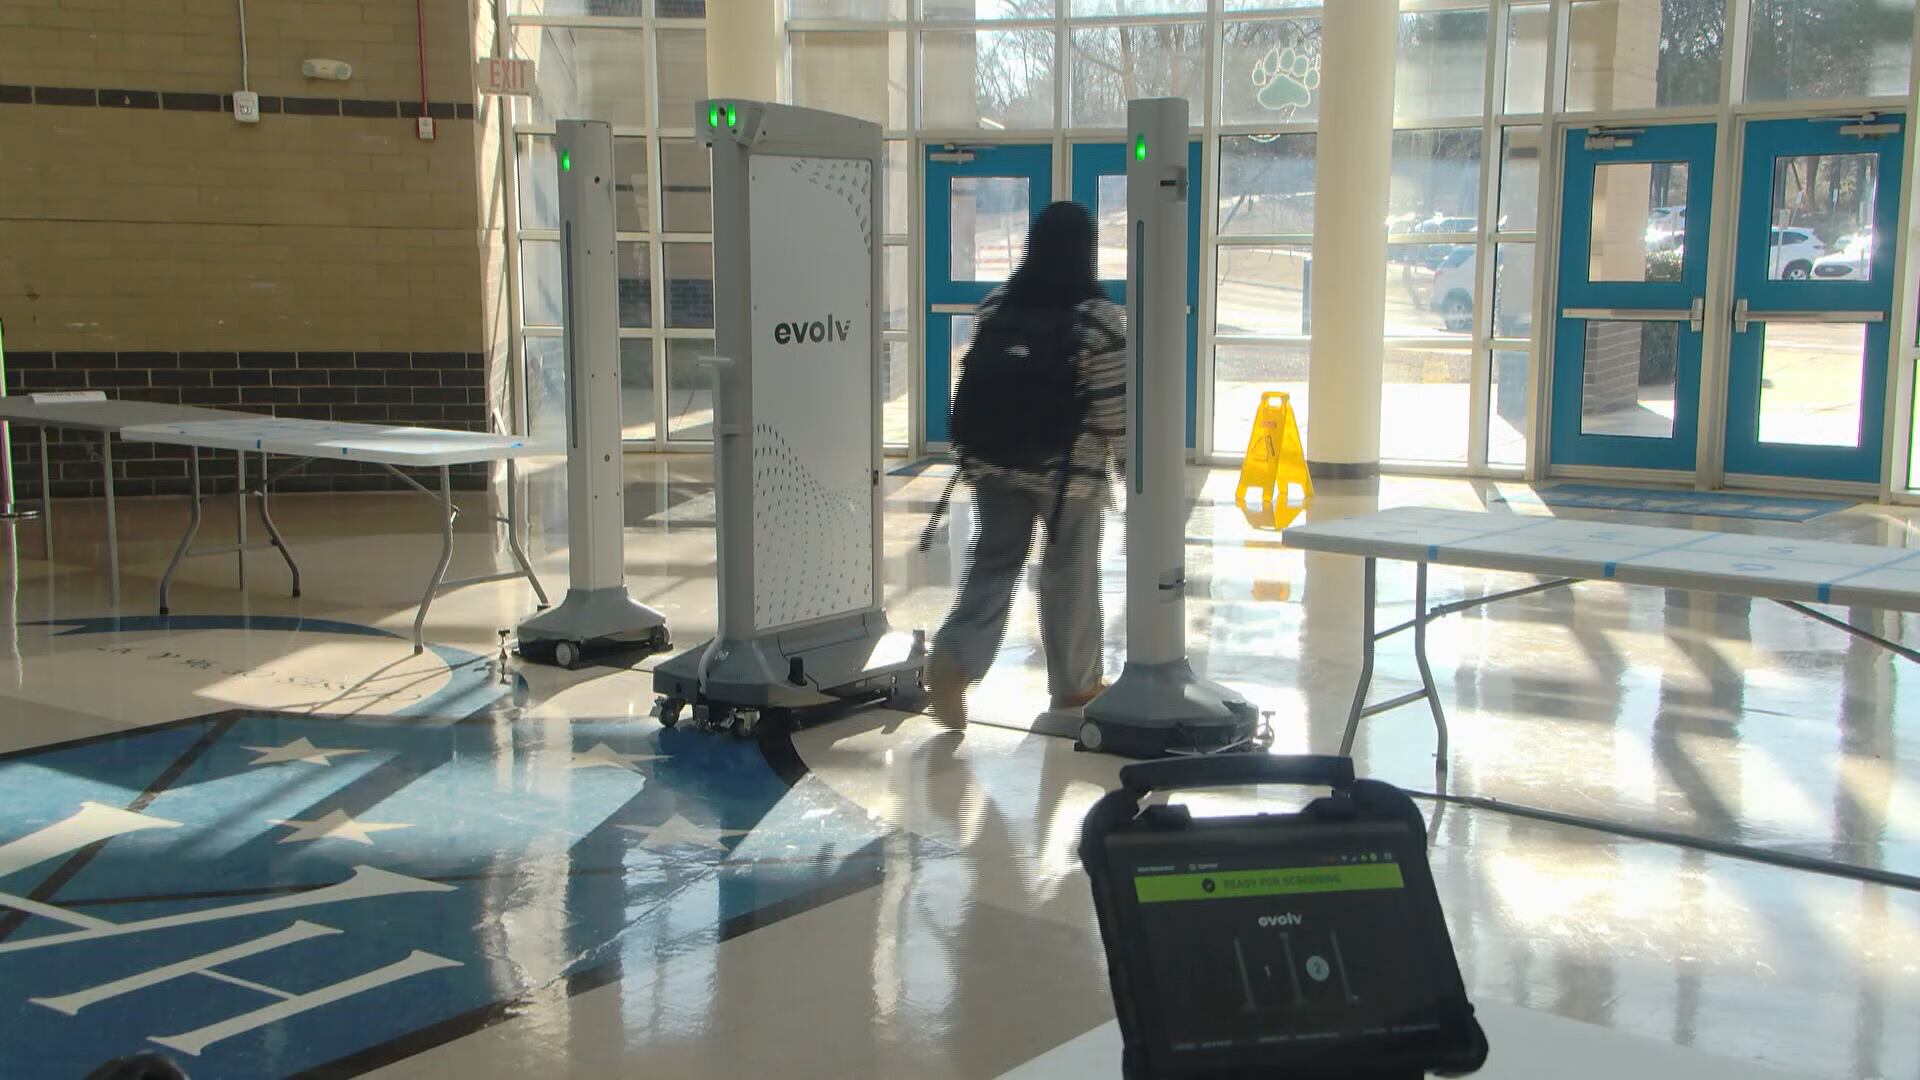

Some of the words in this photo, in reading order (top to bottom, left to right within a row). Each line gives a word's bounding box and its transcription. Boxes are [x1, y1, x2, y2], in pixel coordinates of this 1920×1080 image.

[489, 60, 527, 89] EXIT
[775, 314, 851, 344] evolv
[1223, 877, 1257, 890] READY
[1260, 876, 1281, 888] FOR
[1283, 874, 1342, 887] SCREENING
[1258, 912, 1302, 927] evolv
